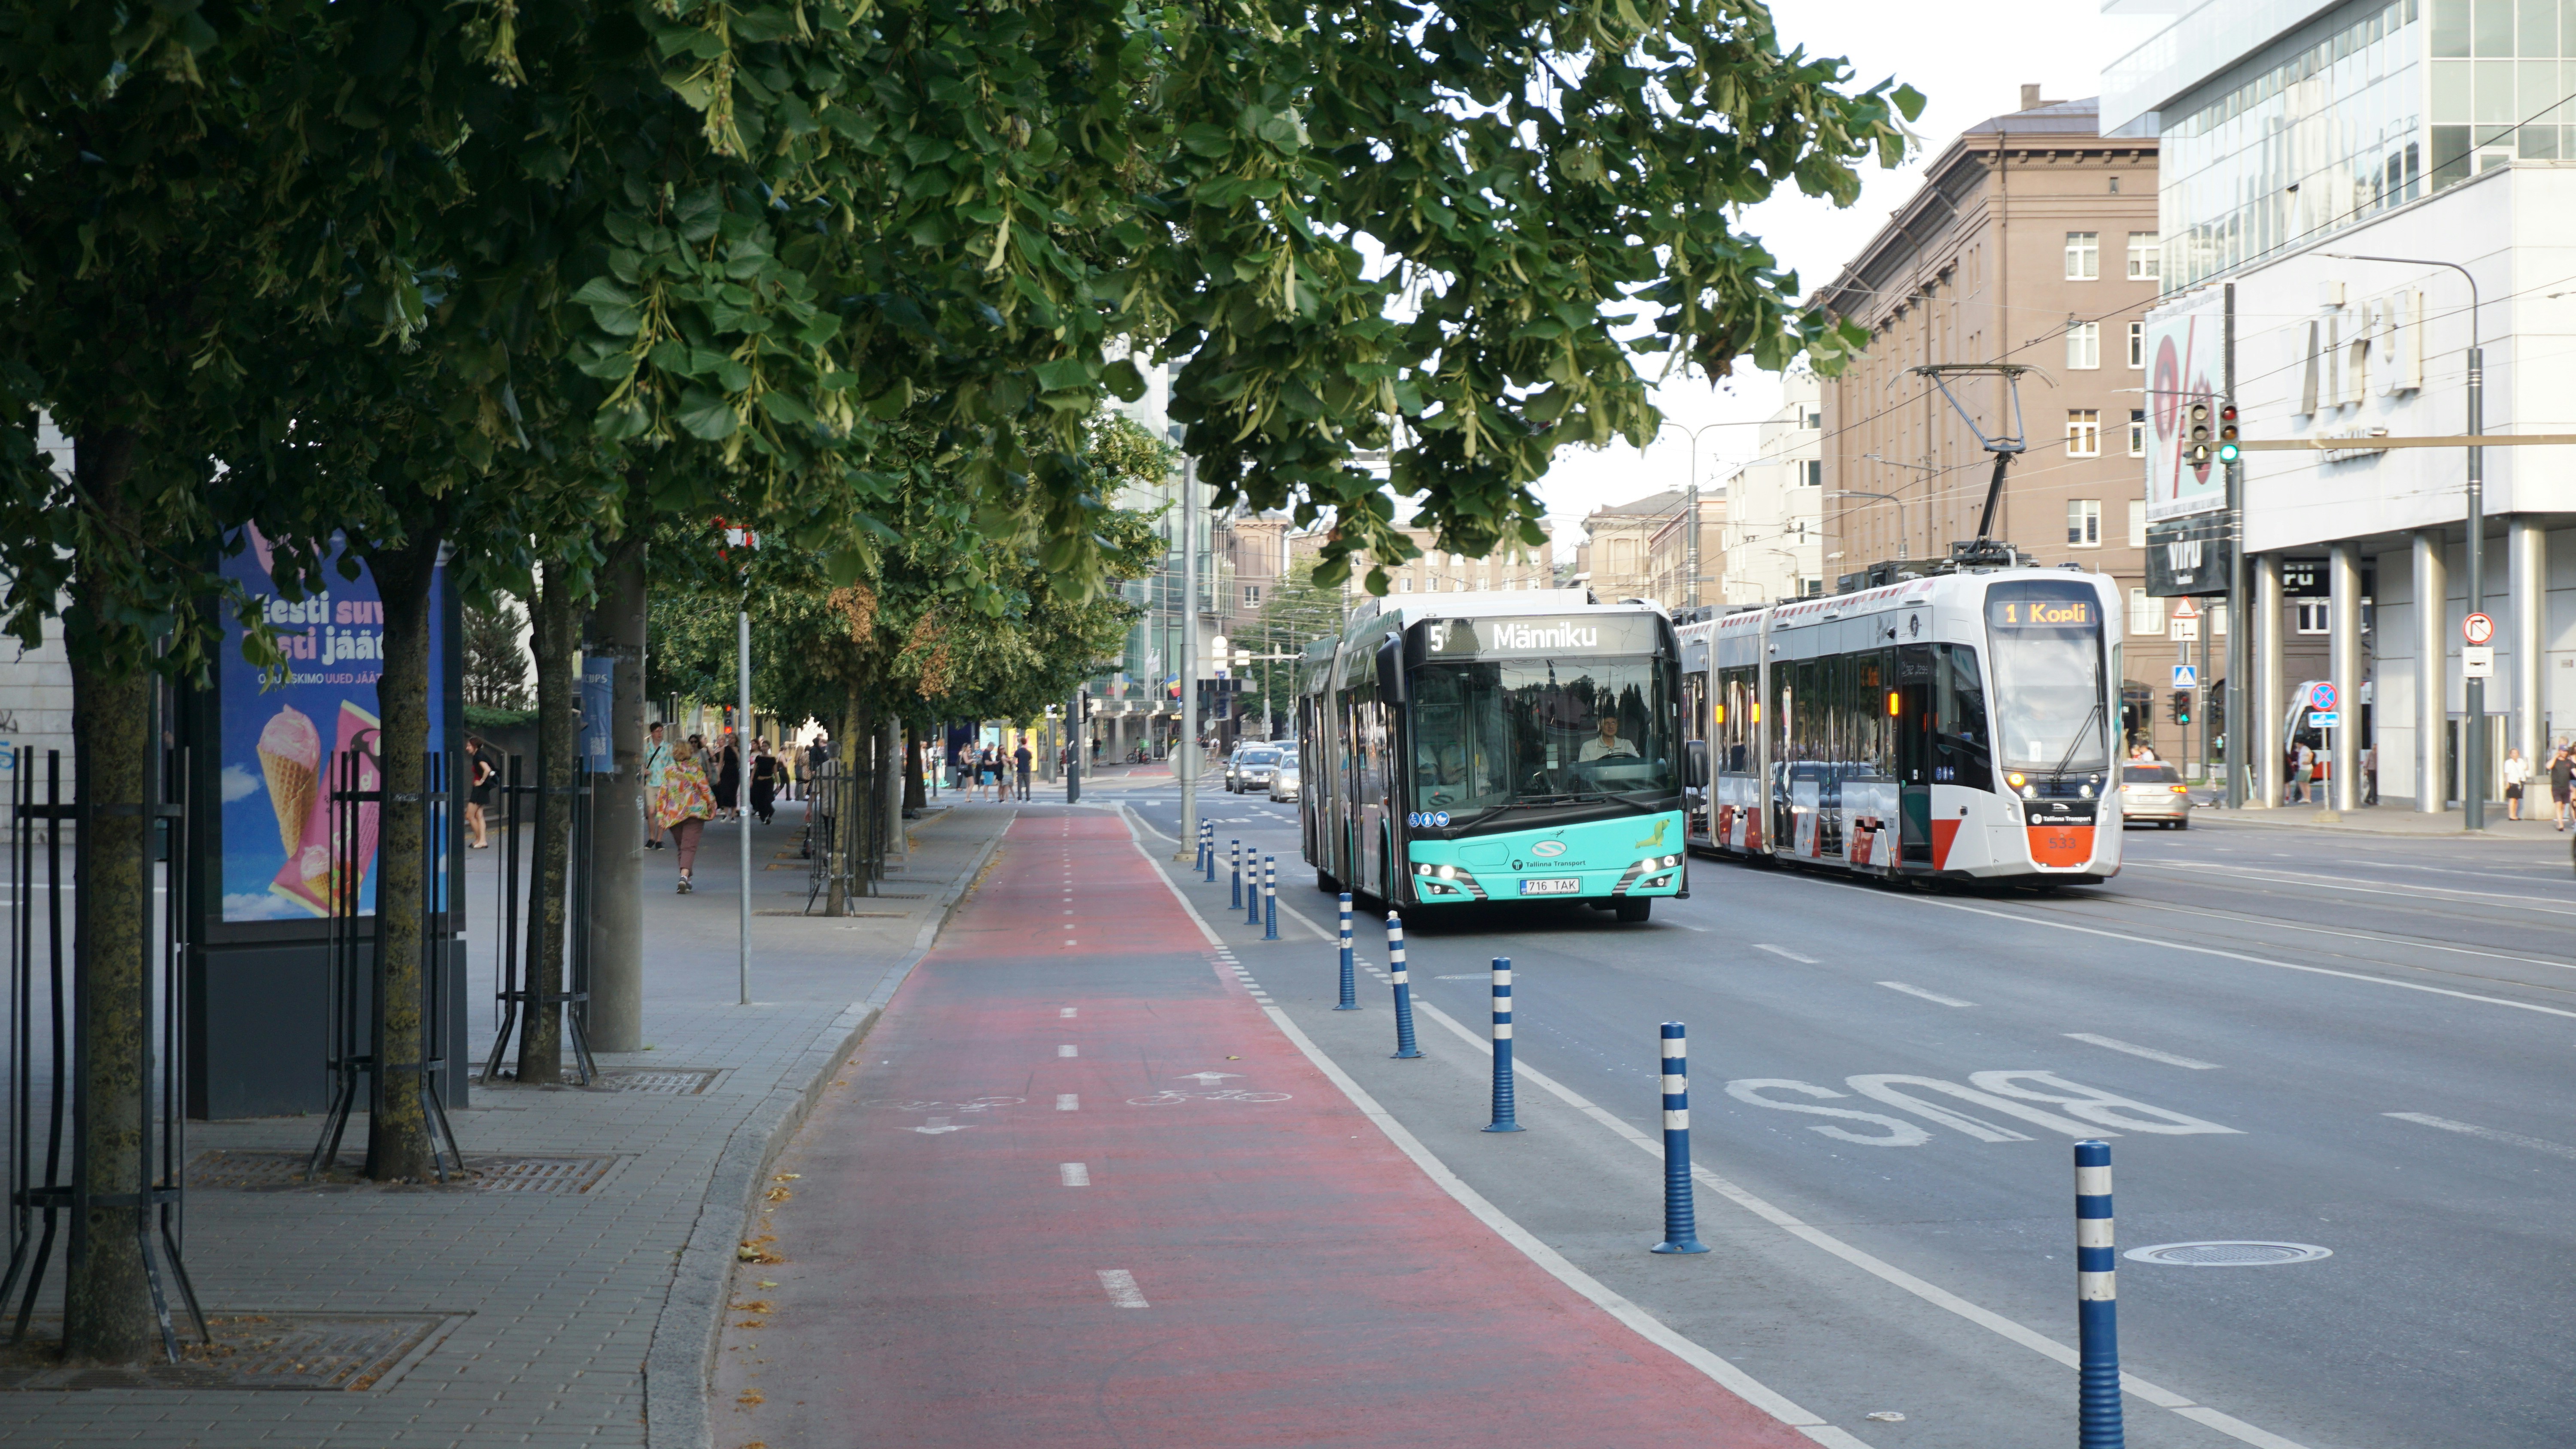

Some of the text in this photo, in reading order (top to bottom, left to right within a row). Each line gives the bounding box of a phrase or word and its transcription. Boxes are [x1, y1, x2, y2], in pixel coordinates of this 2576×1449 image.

[2280, 280, 2423, 416] viru
[2168, 533, 2201, 570] viru
[2006, 603, 2086, 622] 1 Kopli
[1430, 622, 1597, 652] 5 Männiku
[325, 673, 353, 684] UUED
[2049, 838, 2076, 849] 533
[1529, 880, 1576, 891] 716 TAK
[1724, 1070, 2249, 1147] BUS
